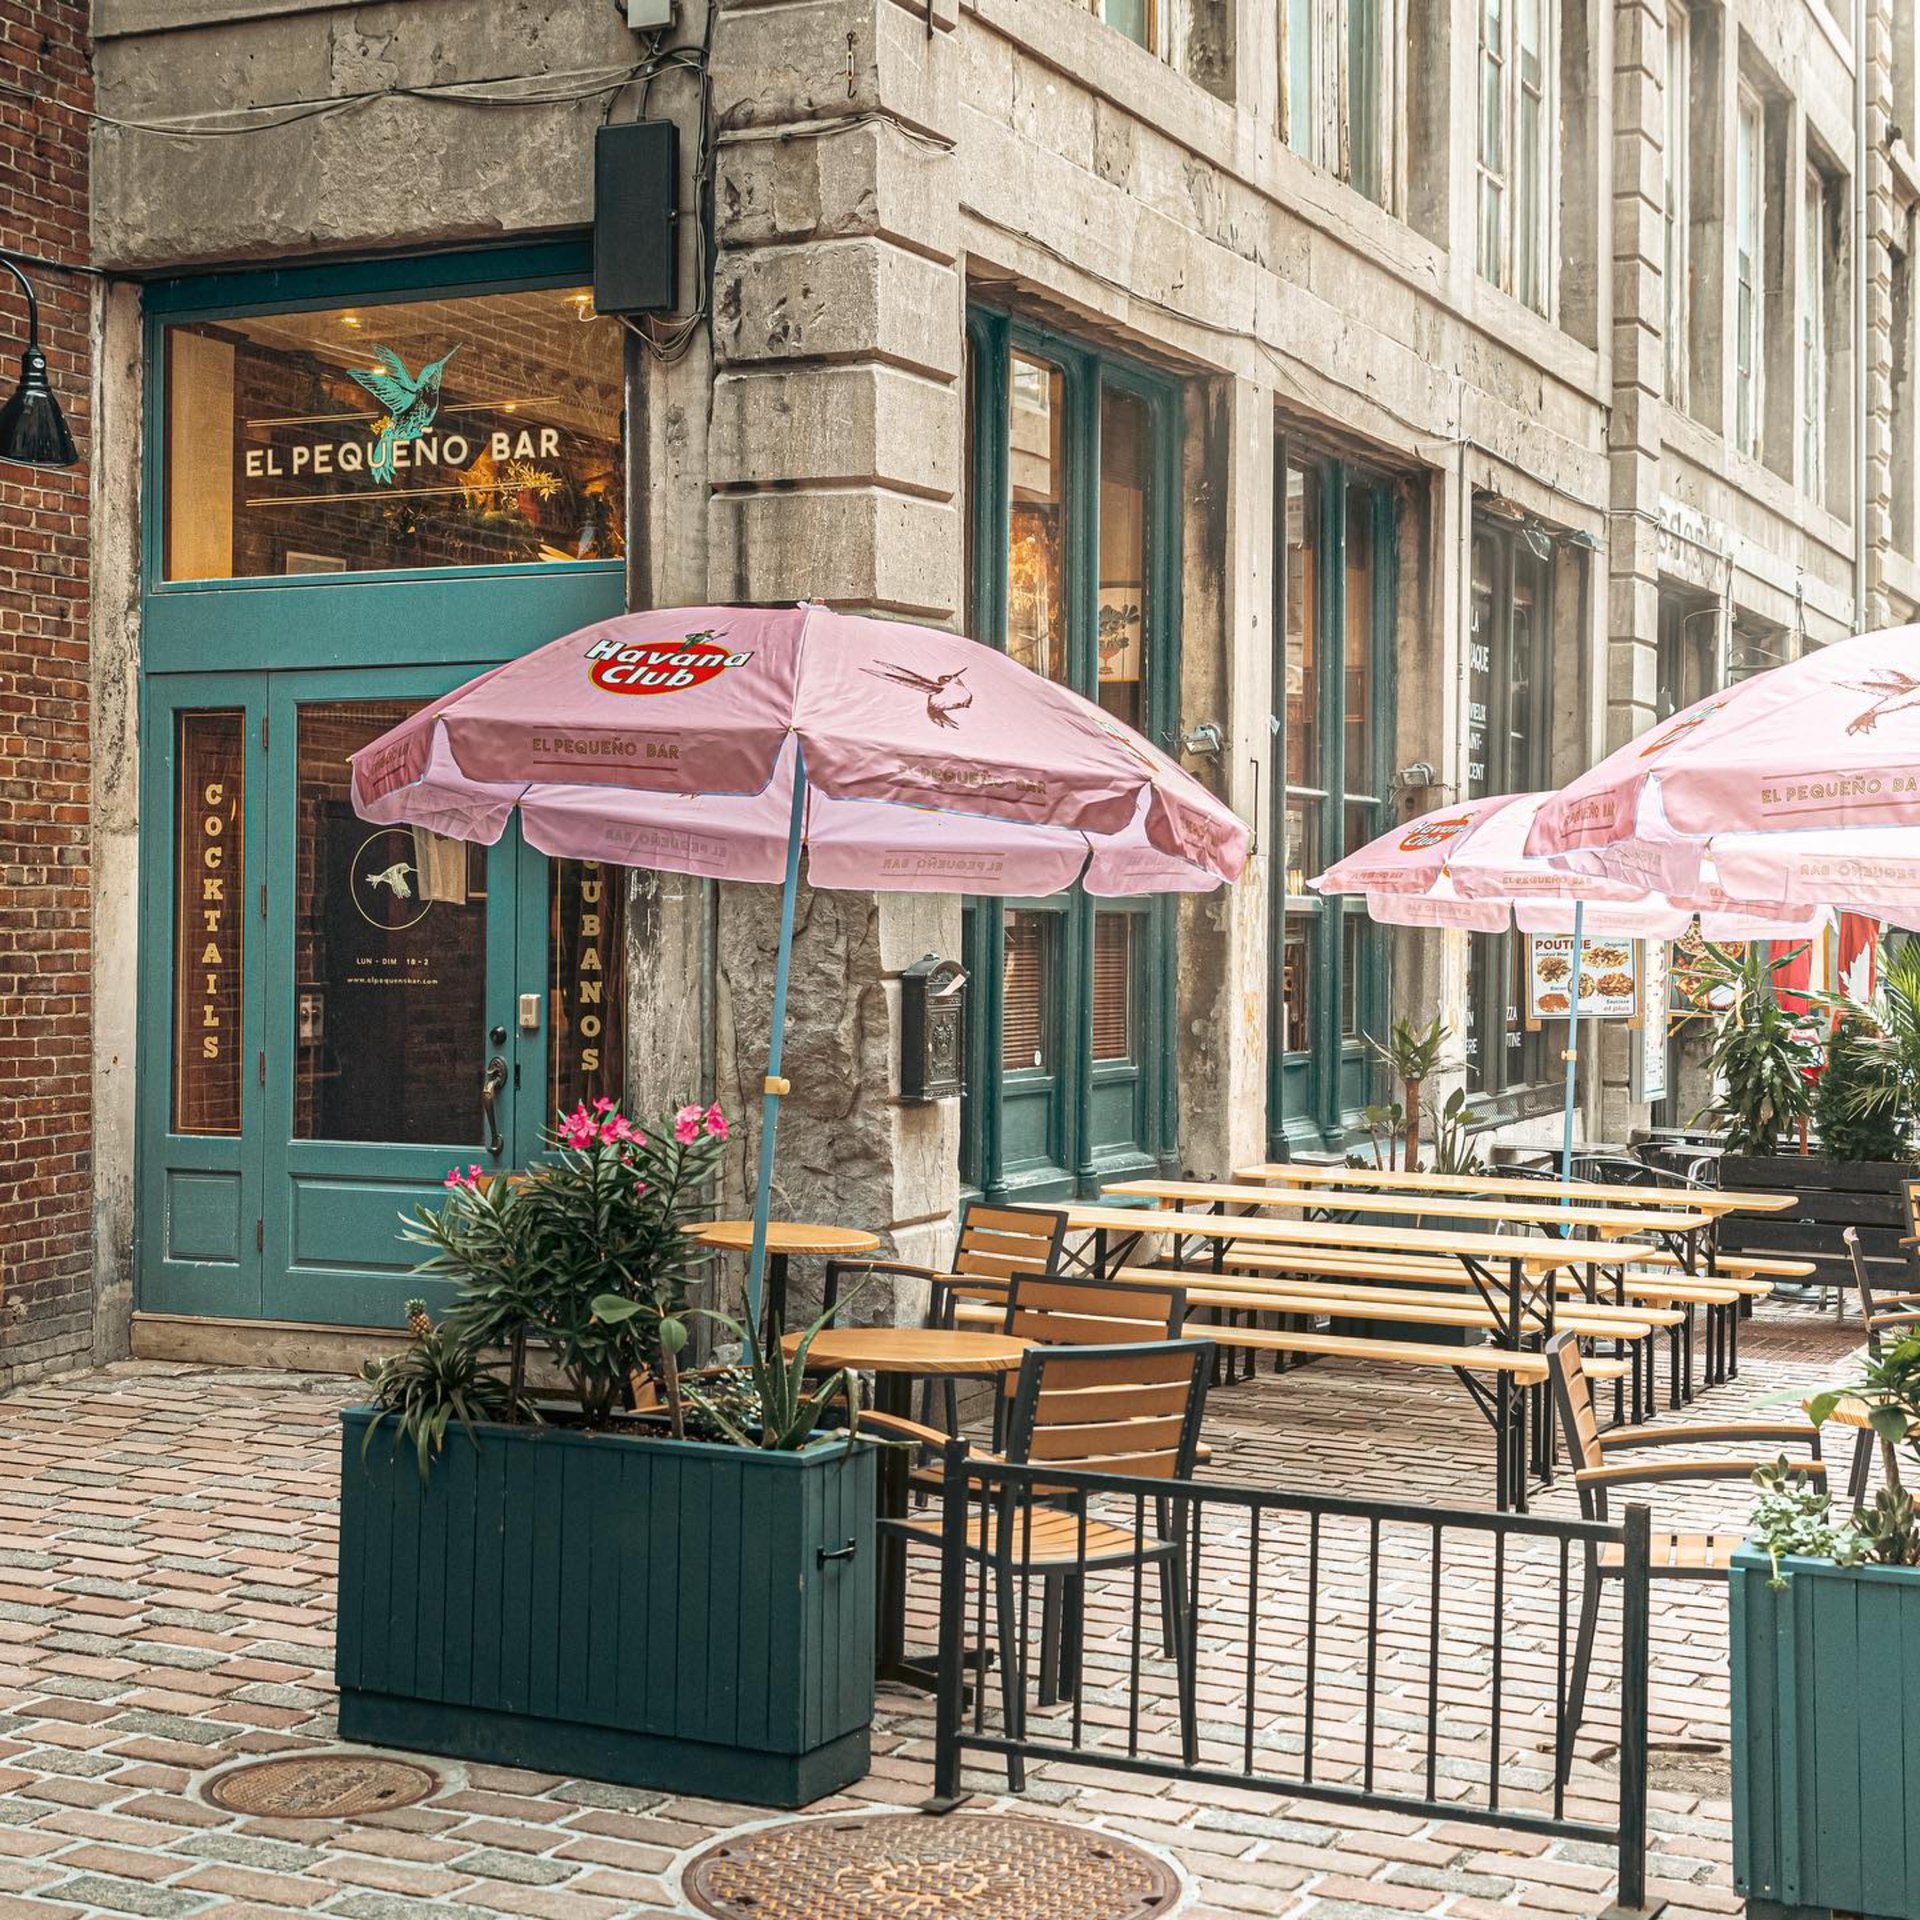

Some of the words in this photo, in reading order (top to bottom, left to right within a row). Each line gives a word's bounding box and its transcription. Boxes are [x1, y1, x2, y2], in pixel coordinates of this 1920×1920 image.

[246, 449, 283, 477] EL
[292, 426, 468, 475] PEQUEÑO
[491, 428, 560, 461] BAR
[584, 638, 755, 668] Havana
[1471, 643, 1489, 675] AQUE
[600, 664, 696, 687] Club
[533, 738, 550, 751] EL
[554, 737, 637, 756] PEQUEÑO
[646, 743, 680, 760] BAR
[1761, 790, 1782, 804] EL
[1786, 775, 1882, 802] PEQUEÑO
[1892, 776, 1918, 793] BA
[202, 783, 224, 1059] COCKTAILS
[1535, 939, 1592, 951] POUTIE
[356, 957, 373, 966] LUN
[381, 957, 397, 966] DIM
